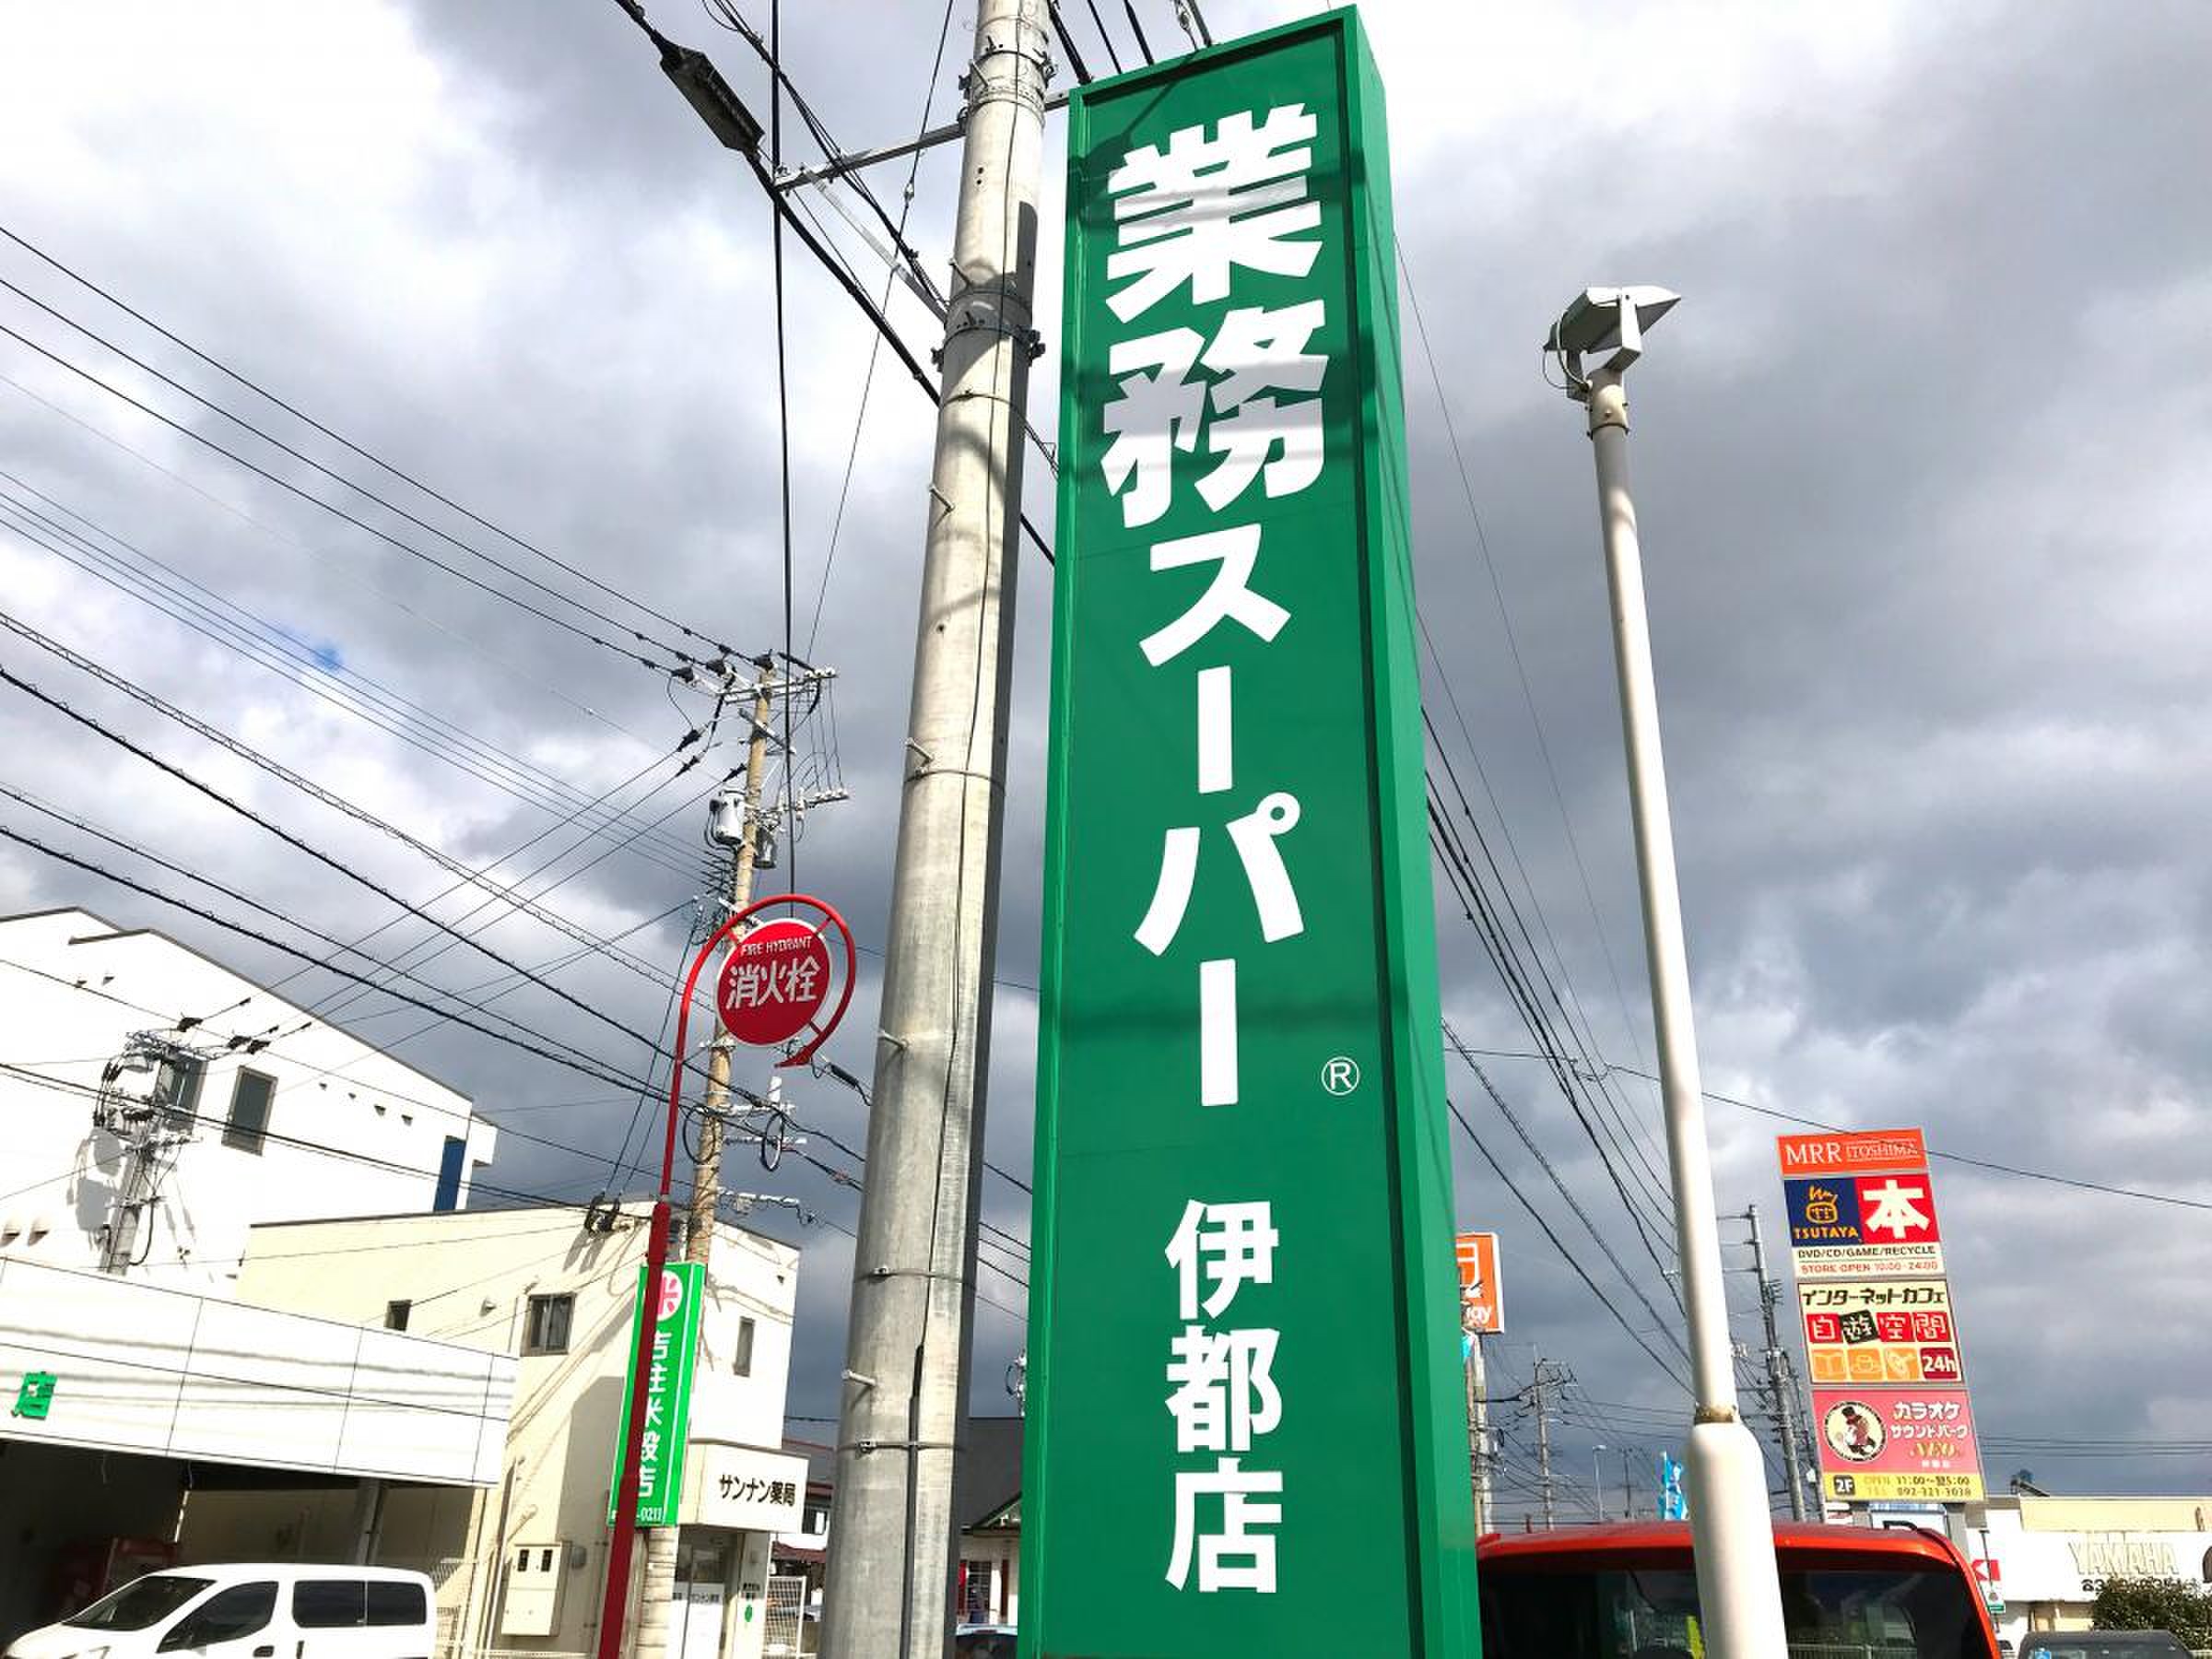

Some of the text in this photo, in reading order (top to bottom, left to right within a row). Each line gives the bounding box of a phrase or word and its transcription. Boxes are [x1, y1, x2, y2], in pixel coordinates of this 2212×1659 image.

[1100, 102, 1329, 1107] 業務スーパー
[740, 936, 813, 957] FIRE HYDRANT
[725, 955, 821, 1010] 消火栓
[1784, 1142, 1842, 1166] MRR
[1863, 1179, 1930, 1240] 本
[1794, 1226, 1859, 1240] TSUTAYA
[1802, 1288, 1946, 1306] インターネットカフェ
[1924, 1355, 1956, 1373] 24h
[1164, 1198, 1284, 1594] 伊都店
[1893, 1401, 1961, 1420] カラオケ
[719, 1474, 796, 1507] サンナン薬局
[1835, 1477, 1854, 1492] 2F
[2068, 1542, 2181, 1575] YAMAHA
